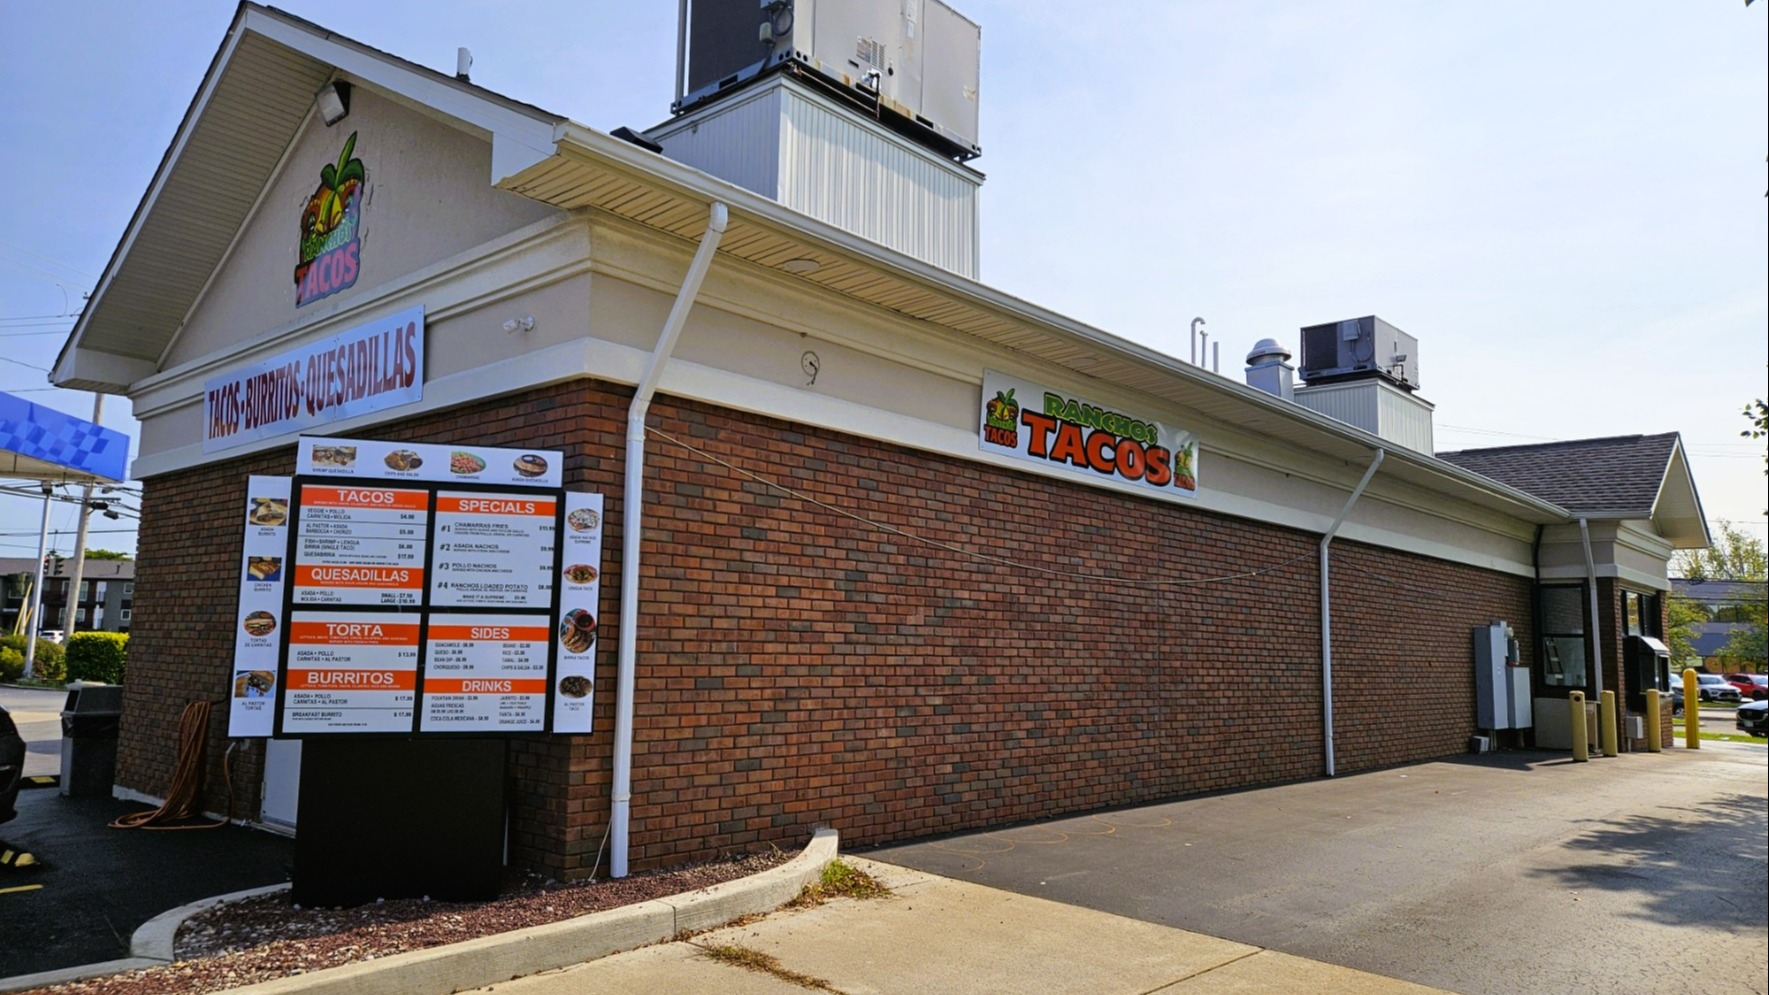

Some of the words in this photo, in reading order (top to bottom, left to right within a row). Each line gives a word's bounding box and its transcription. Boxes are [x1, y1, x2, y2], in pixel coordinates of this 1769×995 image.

[296, 242, 357, 301] TACOS
[208, 380, 241, 439] TACOS
[245, 360, 300, 430] BURRITOS
[306, 321, 416, 417] QUESADILLAS
[1044, 392, 1157, 445] RANCHOS
[984, 424, 1018, 448] TACOS
[1021, 408, 1171, 486] TACOS
[337, 490, 395, 504] TACOS
[459, 500, 535, 514] SPECIALS
[440, 543, 451, 551] #2
[439, 562, 450, 570] #3
[311, 567, 409, 582] QUESADILLAS
[437, 582, 448, 590] #4
[326, 623, 383, 637] TORTA
[470, 627, 510, 639] SIDES
[307, 672, 395, 685] BURRITOS
[462, 680, 512, 692] DRINKS
